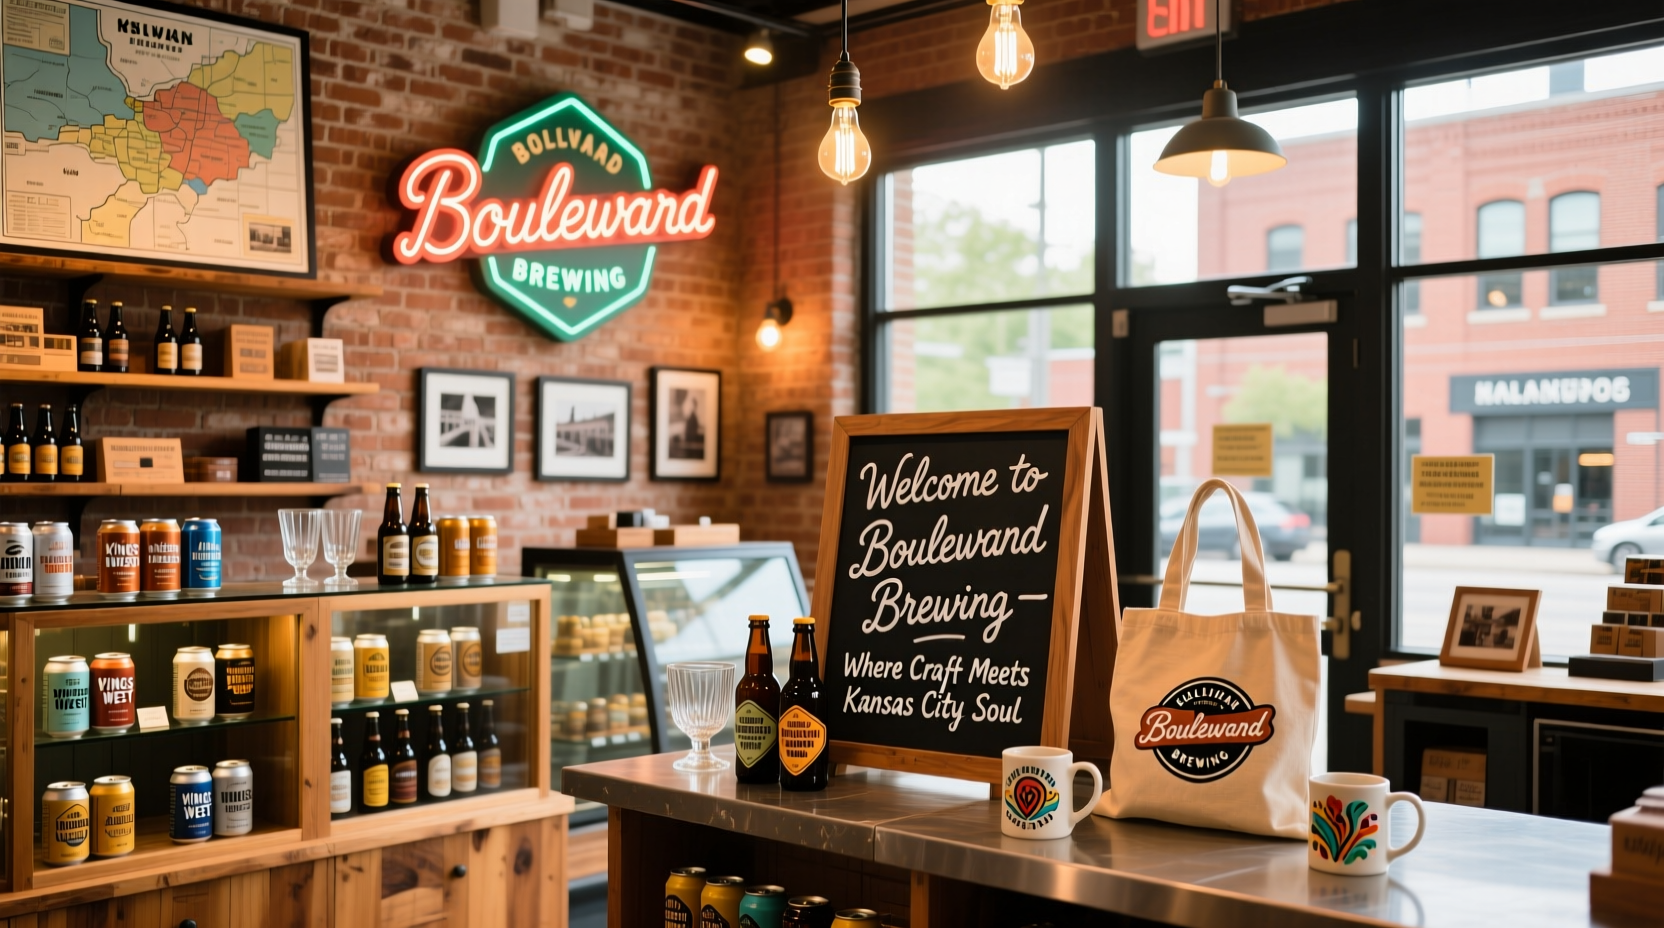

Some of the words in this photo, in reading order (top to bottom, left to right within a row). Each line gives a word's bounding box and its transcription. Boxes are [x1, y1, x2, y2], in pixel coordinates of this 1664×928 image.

[512, 257, 626, 293] BREWING
[860, 452, 999, 510] Welcome
[1009, 453, 1049, 493] to
[862, 577, 1013, 643] Brewing
[843, 651, 903, 680] Where
[909, 655, 963, 694] Craft
[968, 657, 1030, 687] Meets
[842, 685, 914, 717] Kansas
[921, 690, 966, 732] City
[971, 692, 1023, 724] Soul
